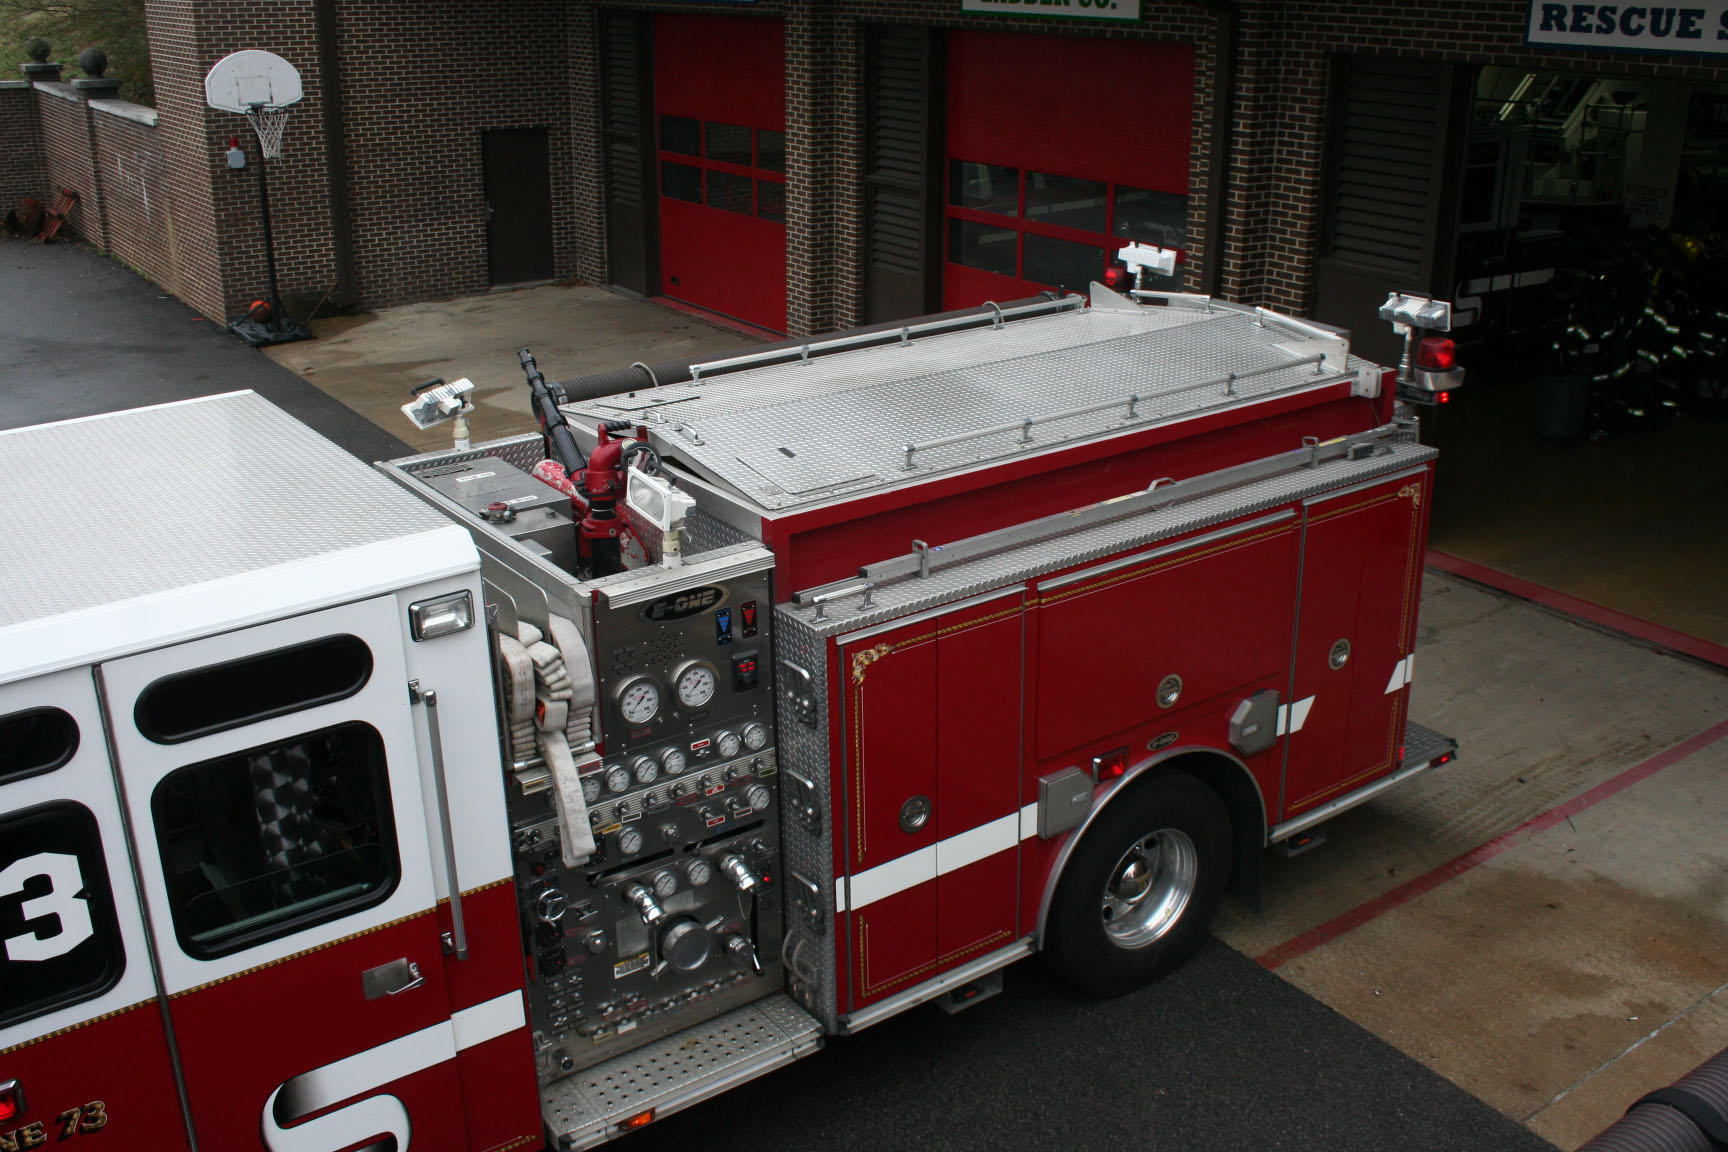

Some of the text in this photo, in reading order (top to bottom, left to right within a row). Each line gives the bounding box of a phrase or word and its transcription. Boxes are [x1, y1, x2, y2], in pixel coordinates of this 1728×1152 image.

[1539, 3, 1706, 40] RESCUE
[0, 852, 95, 962] 3
[56, 1100, 108, 1139] 73
